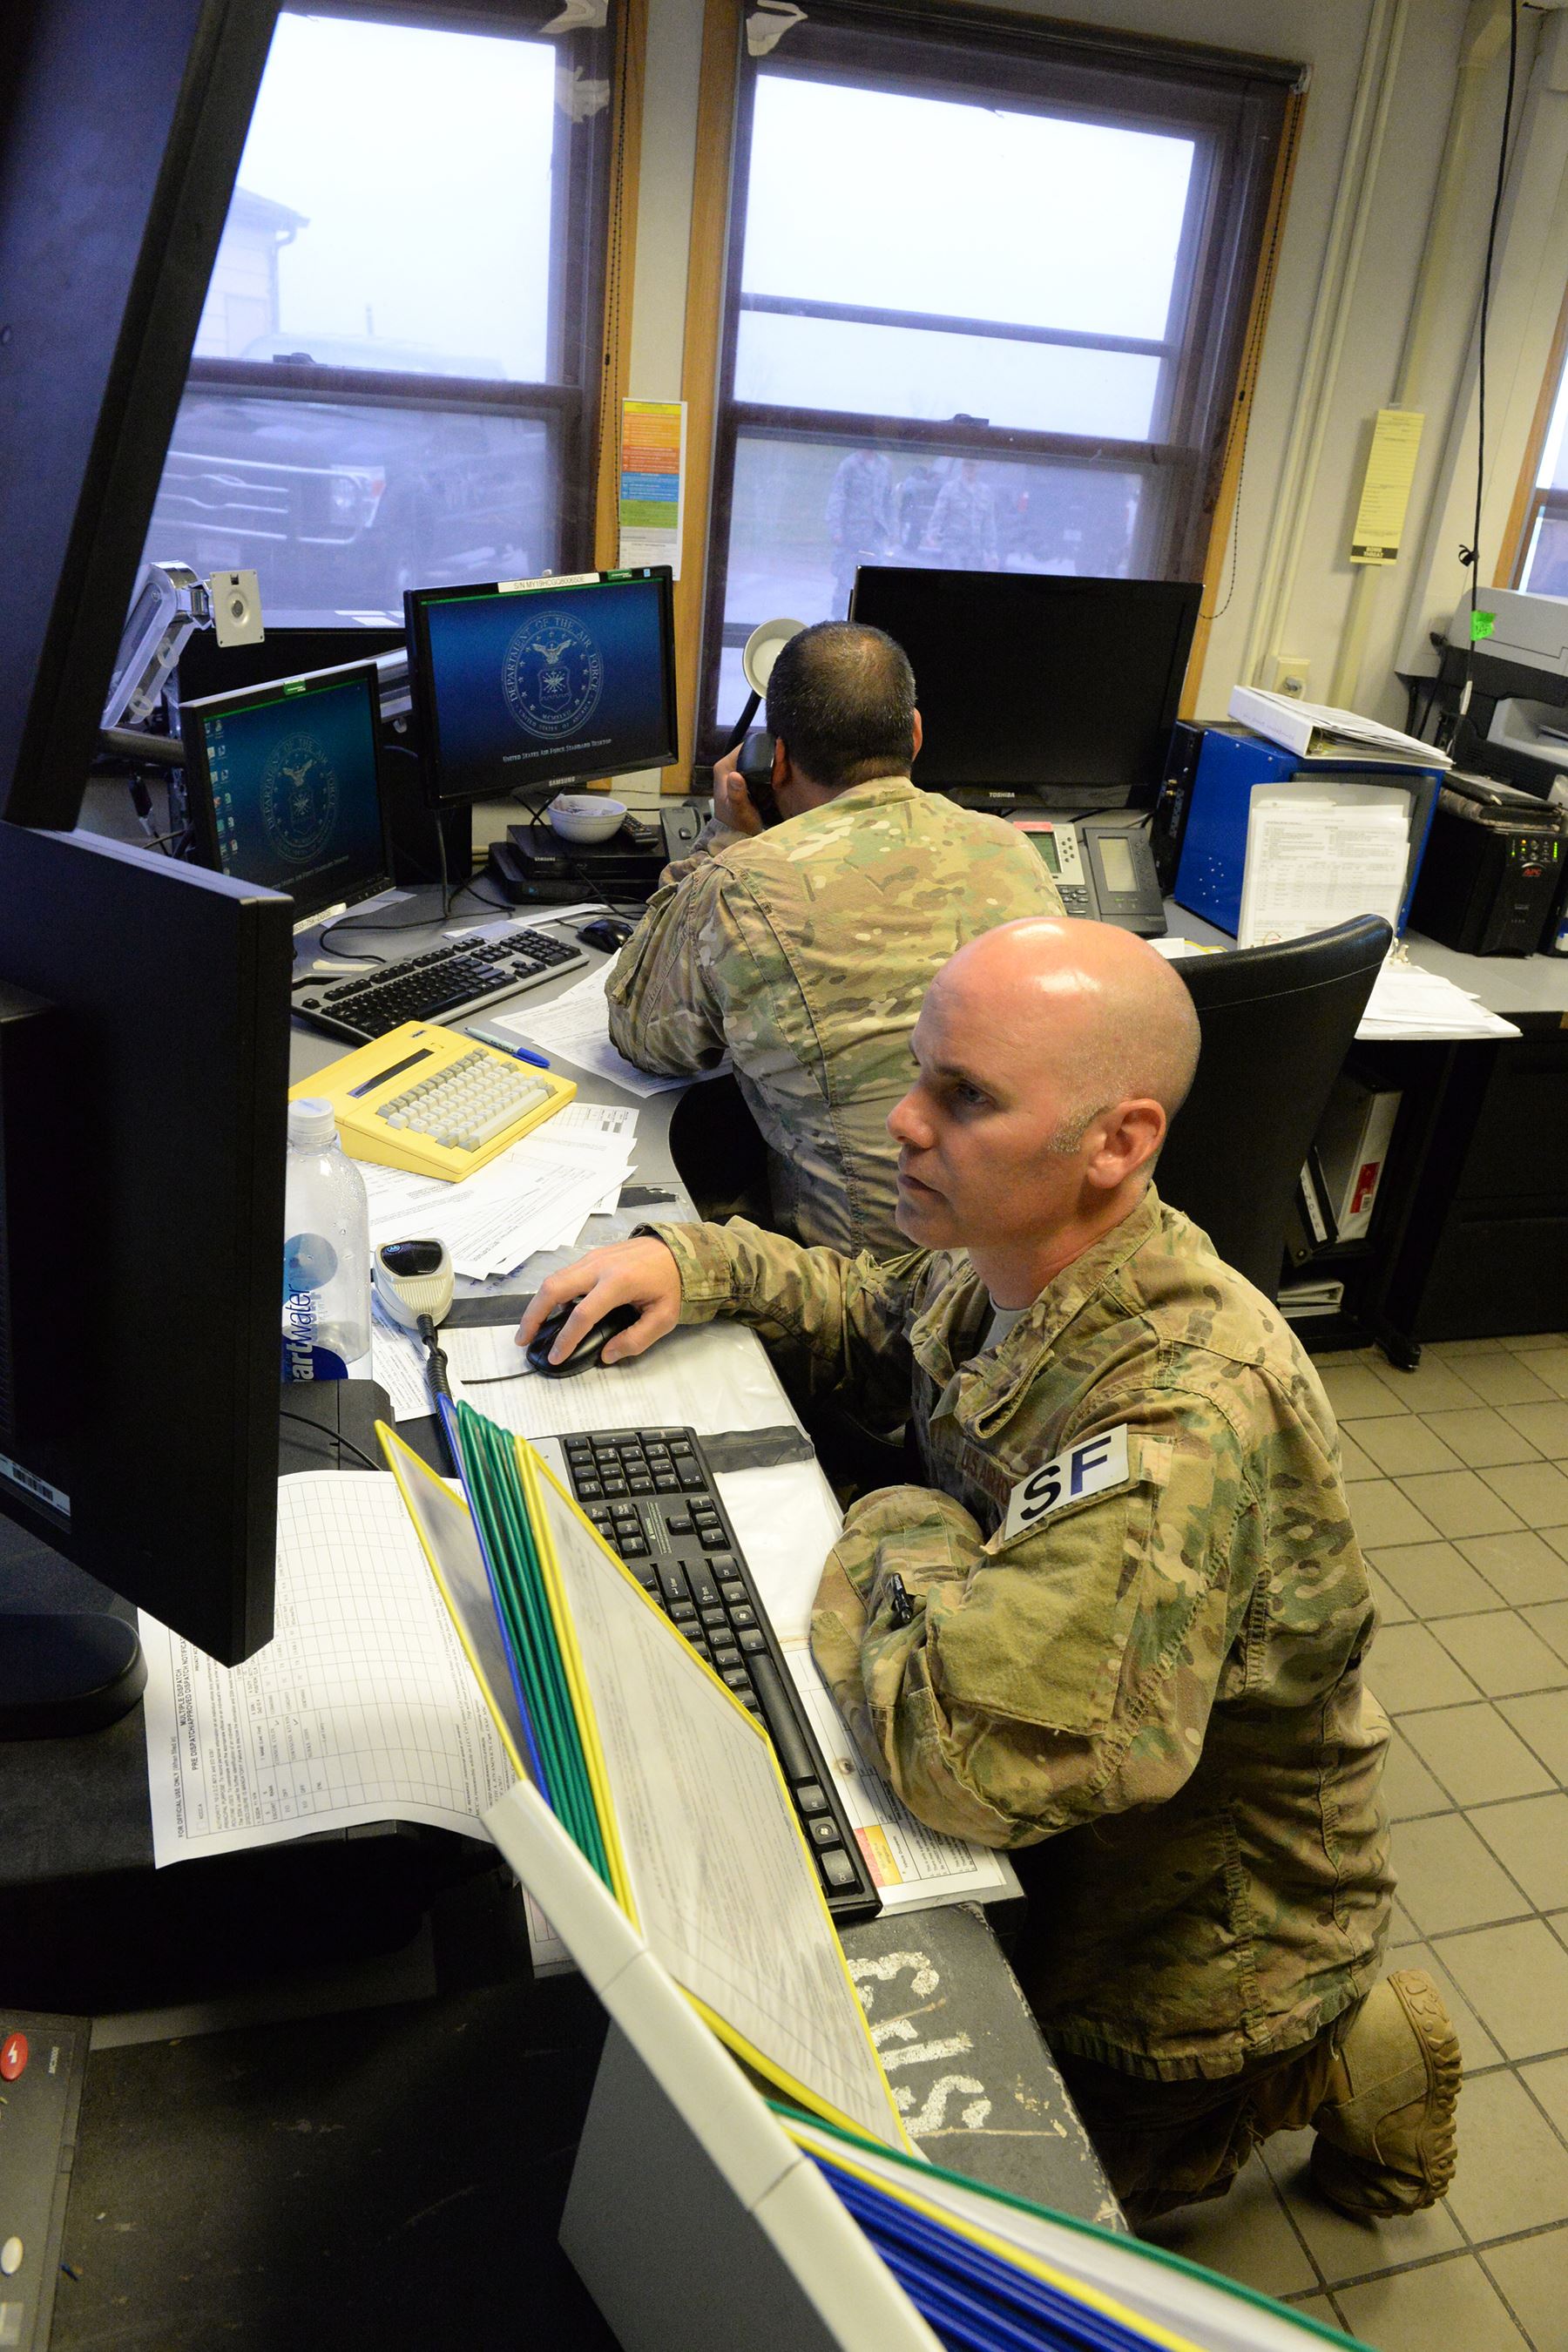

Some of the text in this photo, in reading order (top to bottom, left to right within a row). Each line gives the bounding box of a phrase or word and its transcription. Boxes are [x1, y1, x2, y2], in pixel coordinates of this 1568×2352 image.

[535, 618, 549, 628] OF
[555, 617, 574, 628] THE
[577, 631, 592, 648] AIR
[589, 652, 600, 692] FORCE
[549, 776, 576, 787] SAMSUNG
[1020, 1436, 1112, 1521] SF
[175, 1669, 186, 1727] MULTIPLE DISPATCH
